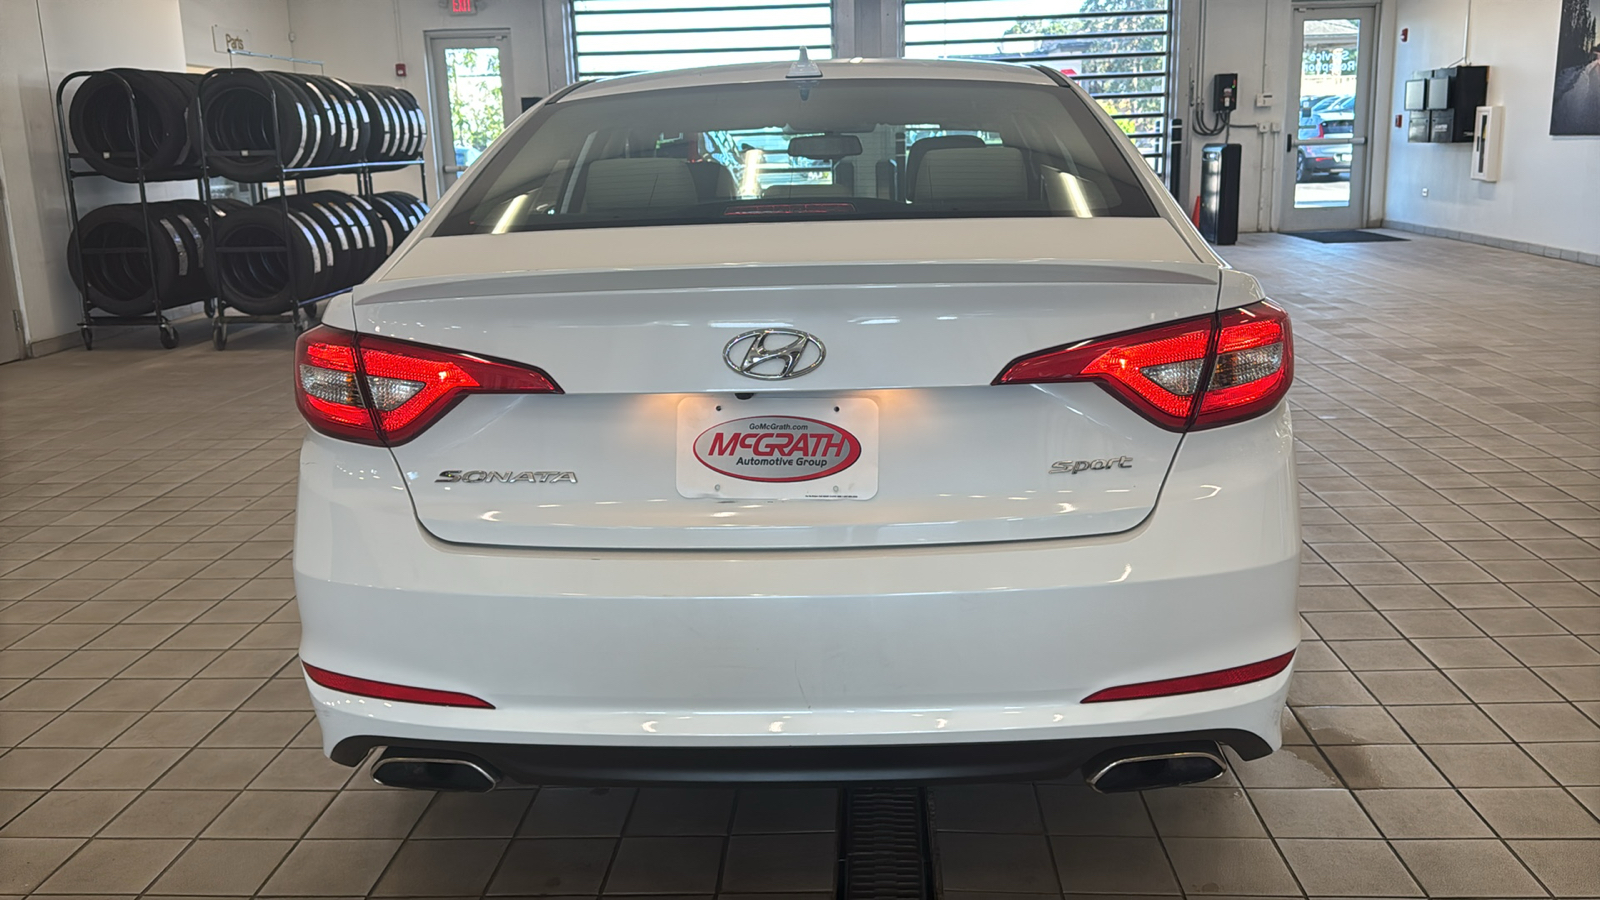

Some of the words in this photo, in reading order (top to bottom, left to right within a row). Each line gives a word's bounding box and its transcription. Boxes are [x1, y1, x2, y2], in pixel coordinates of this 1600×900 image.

[749, 423, 808, 431] GoMcGrath.com
[736, 457, 794, 466] Automotive
[796, 457, 827, 468] Group
[434, 470, 578, 484] SONATA
